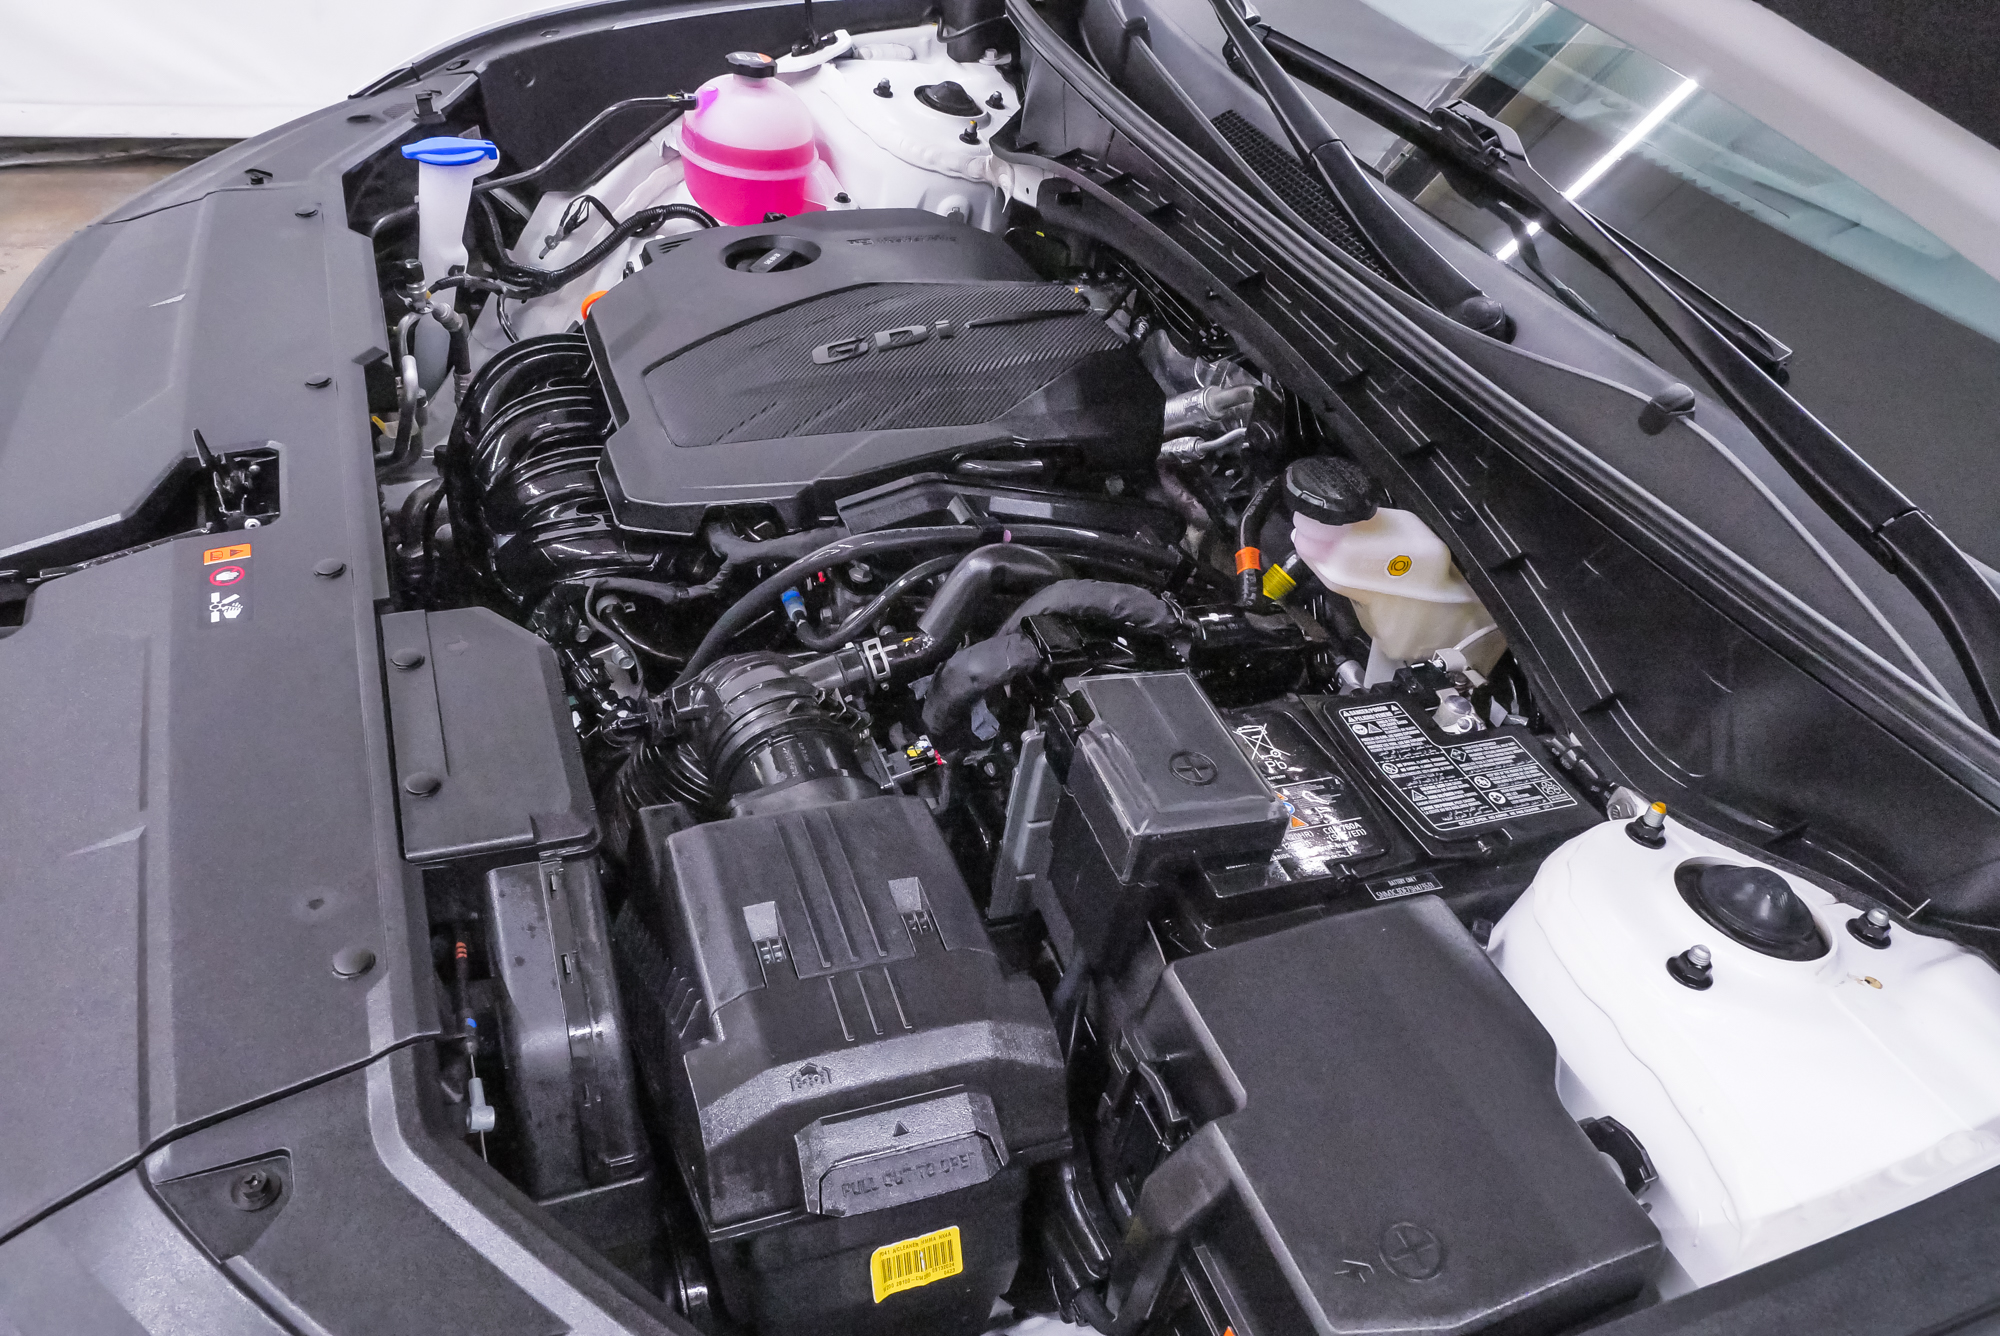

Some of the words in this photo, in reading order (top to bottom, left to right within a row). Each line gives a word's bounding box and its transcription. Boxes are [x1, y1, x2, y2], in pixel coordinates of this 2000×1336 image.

[1264, 759, 1288, 773] Pb
[1341, 822, 1362, 831] 760A
[1329, 828, 1367, 841] (S/EN)
[841, 1177, 879, 1198] PULL
[915, 1162, 937, 1179] TO
